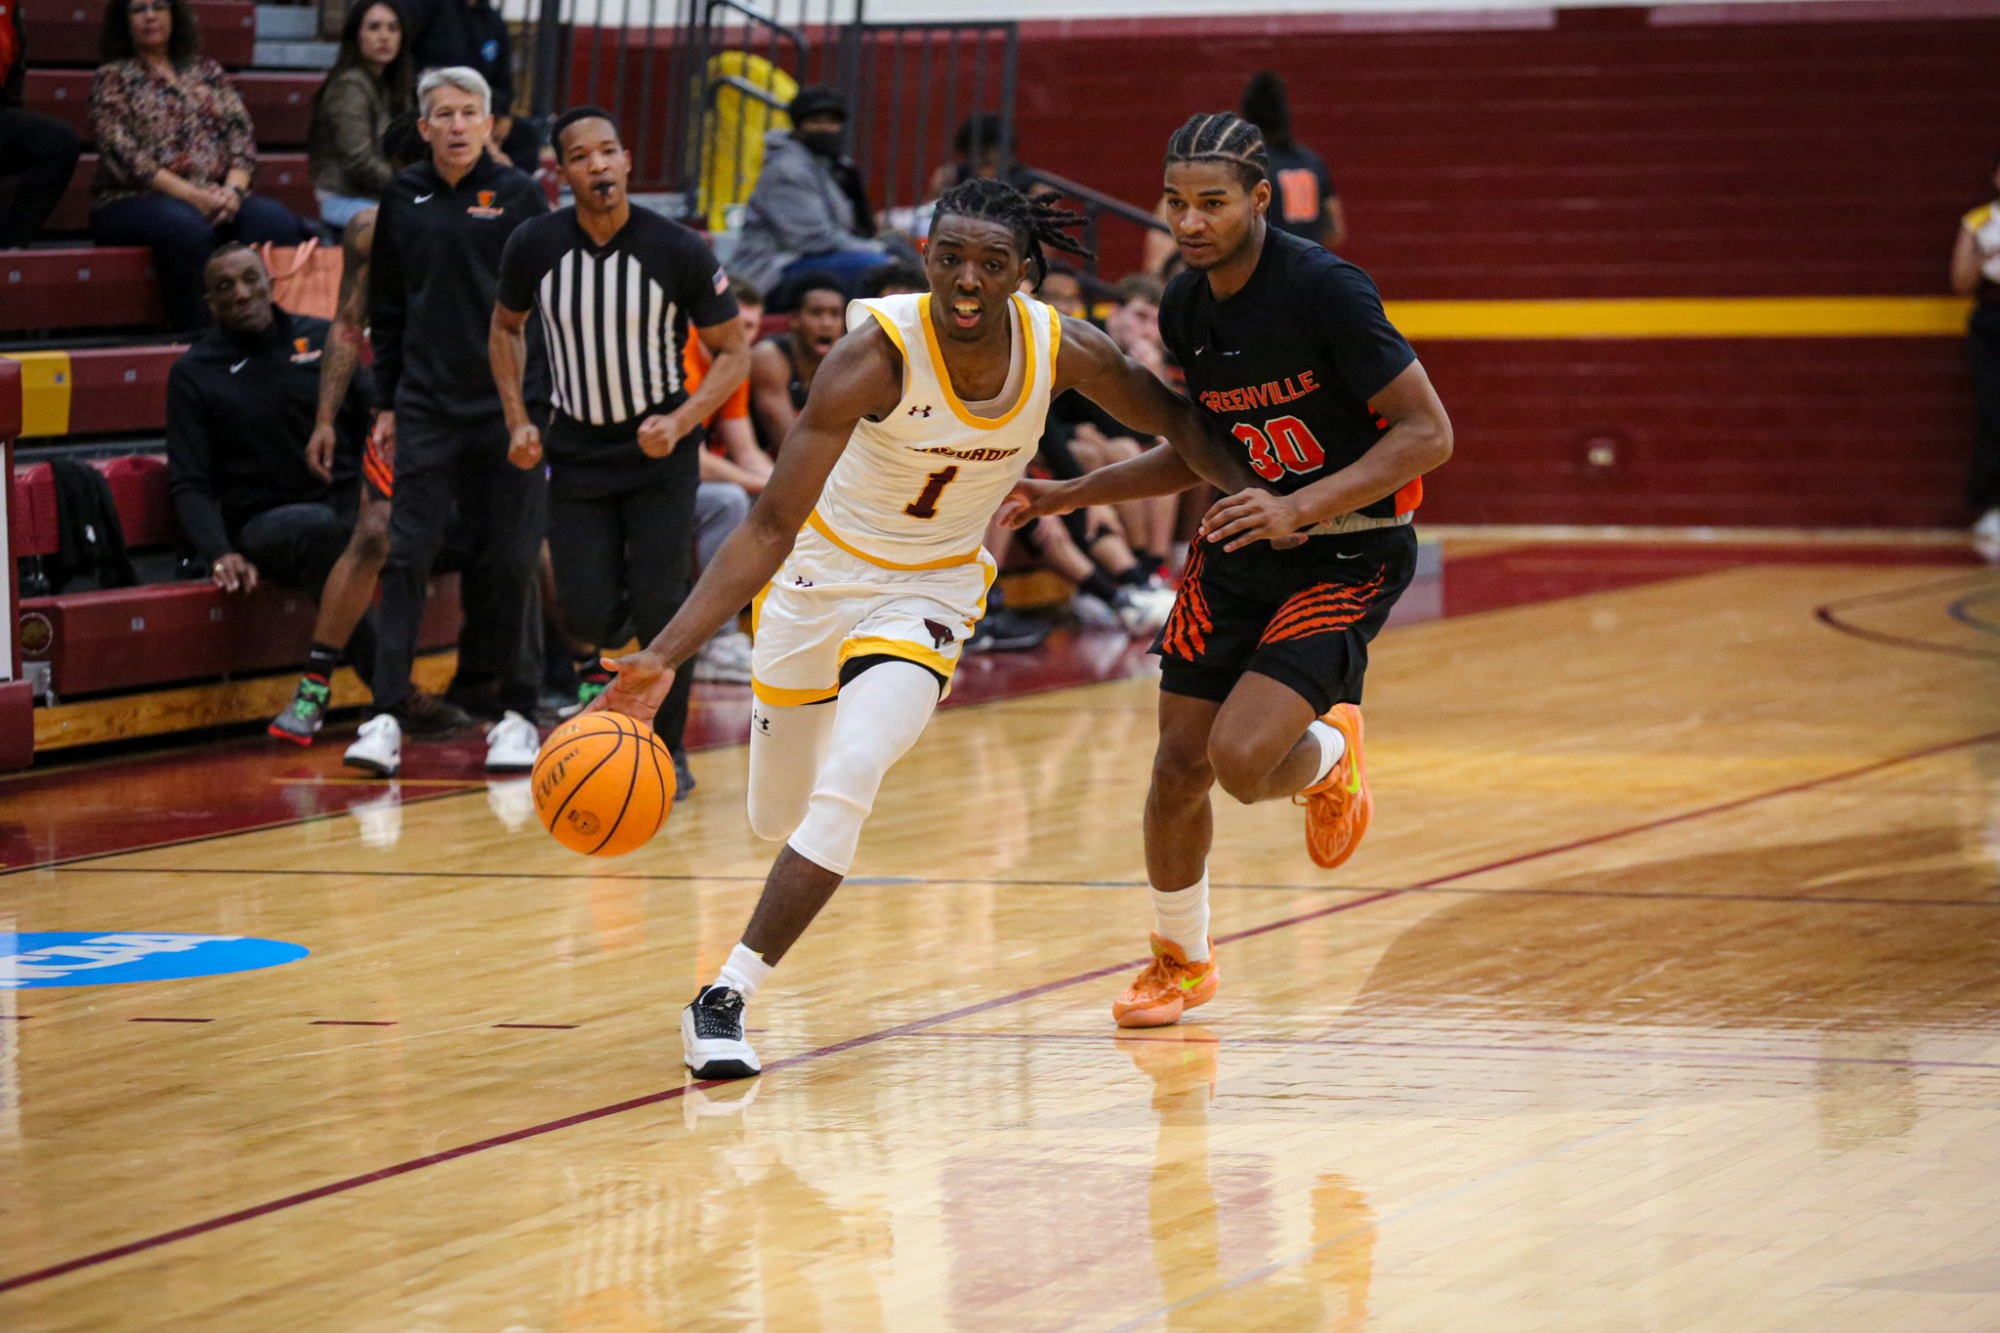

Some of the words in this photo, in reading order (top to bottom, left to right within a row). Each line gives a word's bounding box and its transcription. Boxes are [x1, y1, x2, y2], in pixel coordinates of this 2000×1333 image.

[1199, 370, 1321, 413] GREENVILLE
[1231, 415, 1326, 482] 30
[901, 465, 961, 520] 1
